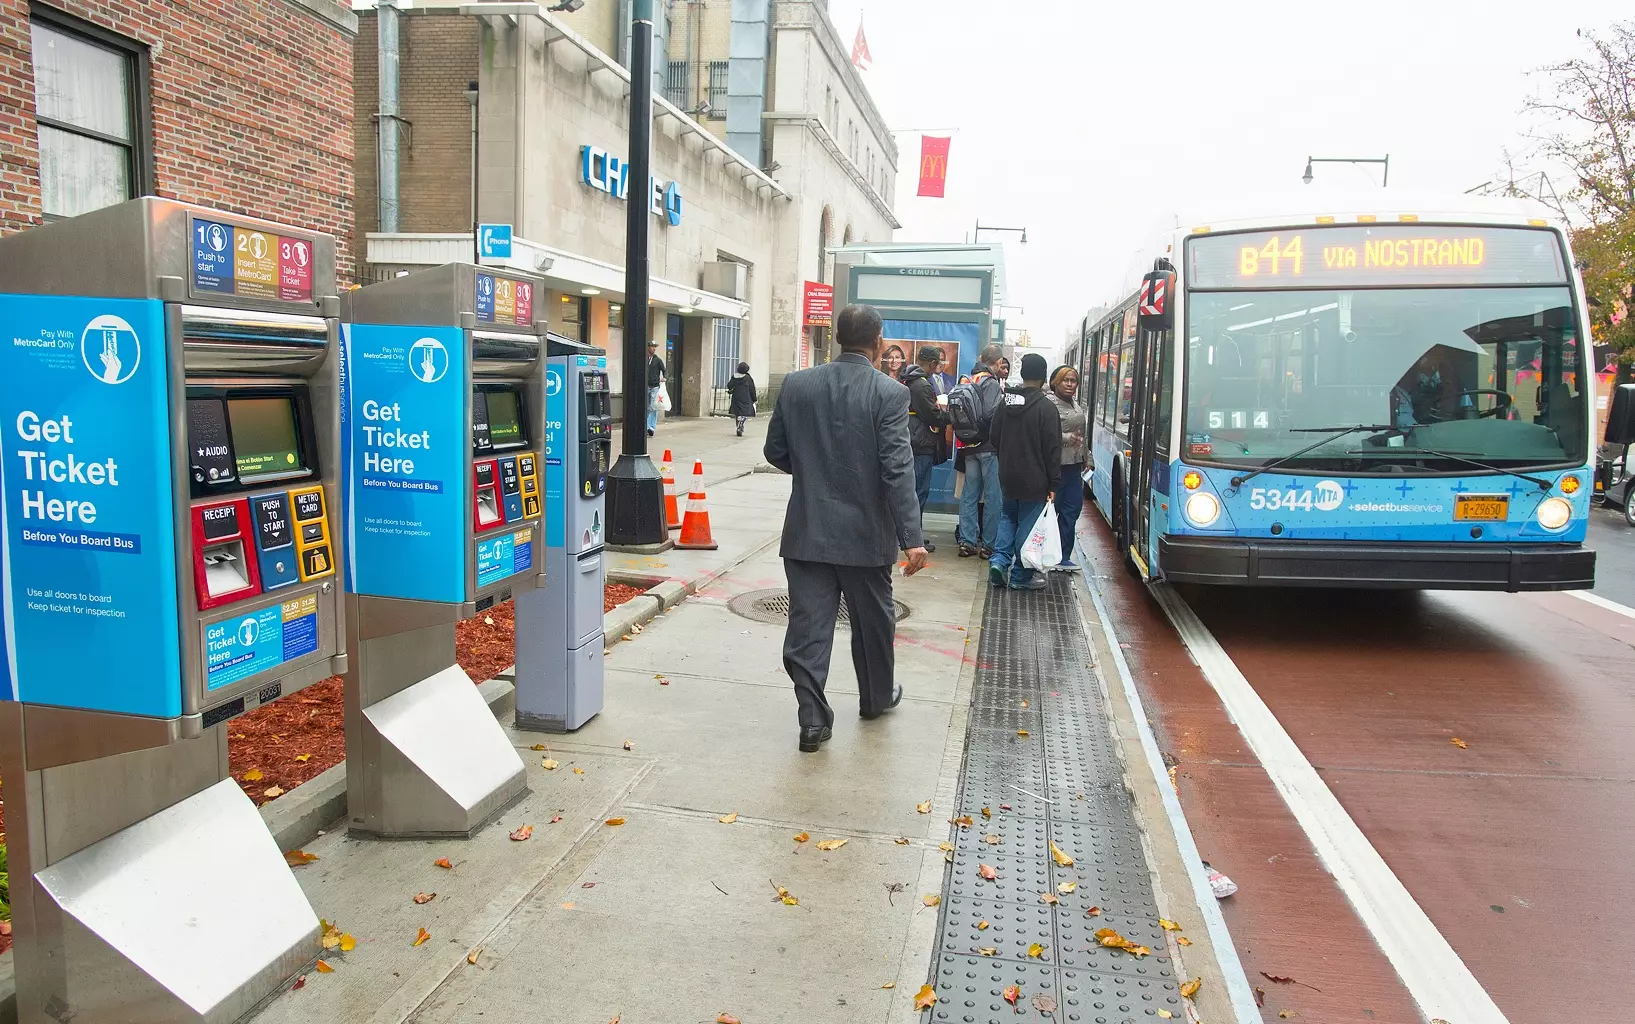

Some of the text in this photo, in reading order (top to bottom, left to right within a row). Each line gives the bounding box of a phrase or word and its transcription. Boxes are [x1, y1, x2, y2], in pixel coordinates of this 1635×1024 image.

[583, 145, 663, 216] CHE
[198, 226, 205, 243] 1
[238, 234, 247, 252] 2
[198, 250, 225, 263] Push to
[282, 243, 291, 260] 3
[1240, 236, 1484, 276] B44 VIA NOSTRAND
[198, 262, 215, 272] start
[238, 258, 256, 269] Insert
[238, 268, 272, 281] MetroCard
[282, 266, 296, 276] Take
[282, 276, 300, 286] Ticket
[41, 329, 74, 340] Pay With
[14, 338, 75, 350] MetroCard Only
[363, 400, 401, 421] Get
[16, 410, 74, 444] Get
[363, 426, 430, 450] Ticket
[206, 446, 228, 457] AUDIO
[18, 450, 119, 486] Ticket
[364, 452, 415, 475] Here
[364, 479, 386, 487] Before
[402, 482, 423, 490] Board
[262, 500, 280, 511] PUSH
[298, 493, 319, 504] METRO
[1250, 488, 1314, 512] 5344
[22, 489, 97, 524] Here
[301, 504, 318, 514] CARD
[204, 507, 235, 521] RECEIPT
[268, 511, 278, 520] TO
[263, 520, 285, 533] START
[23, 530, 134, 548] Before You Board Bus
[27, 588, 112, 603] Use all doors to board
[28, 602, 126, 618] Keep ticket for inspection
[208, 626, 224, 640] Get
[208, 635, 237, 652] Ticket
[209, 651, 231, 664] Here
